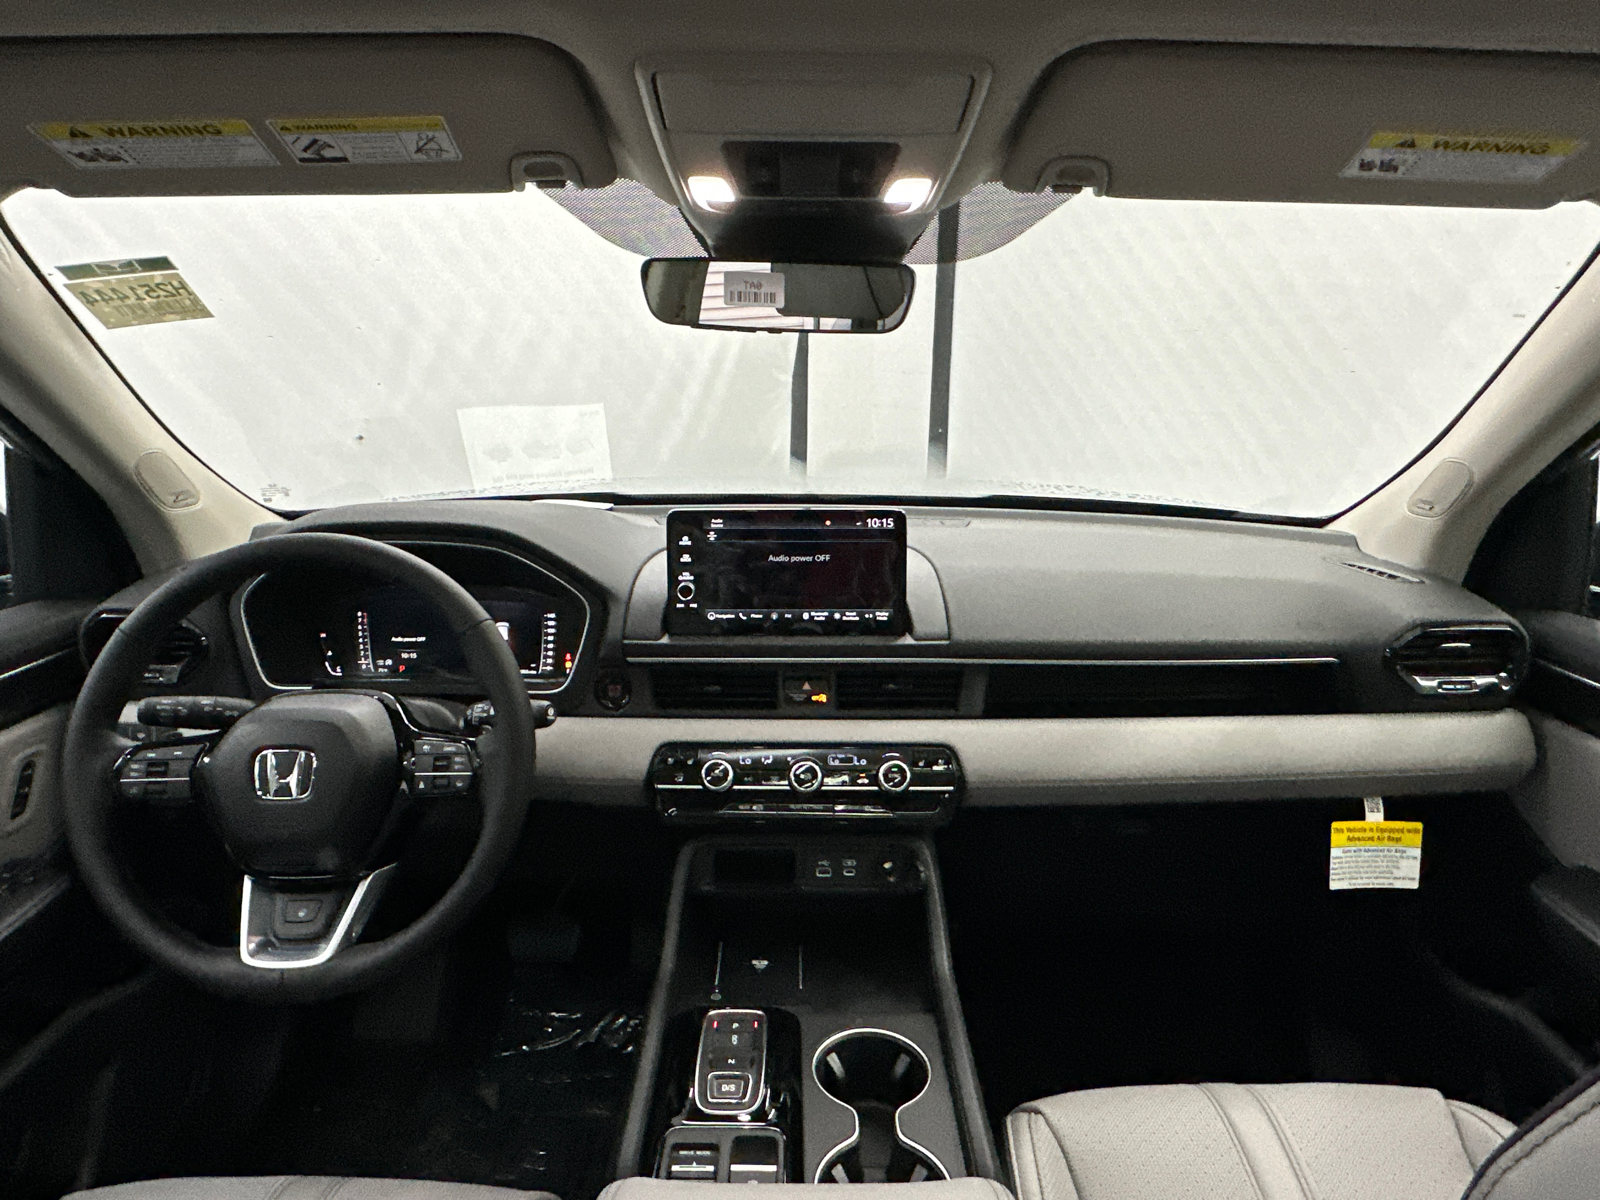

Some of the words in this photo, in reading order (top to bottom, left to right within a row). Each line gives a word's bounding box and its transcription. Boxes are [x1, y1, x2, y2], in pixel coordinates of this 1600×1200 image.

[99, 123, 223, 138] WARNING
[1433, 139, 1551, 155] WARNING
[866, 518, 894, 528] 10:15
[768, 554, 789, 562] Audio
[791, 555, 813, 563] power
[815, 554, 831, 562] OFF
[1332, 826, 1344, 834] This
[1346, 826, 1367, 834] Vehicle
[1376, 826, 1405, 834] Equipped
[1387, 835, 1402, 843] Bags
[721, 1084, 736, 1092] D/S
